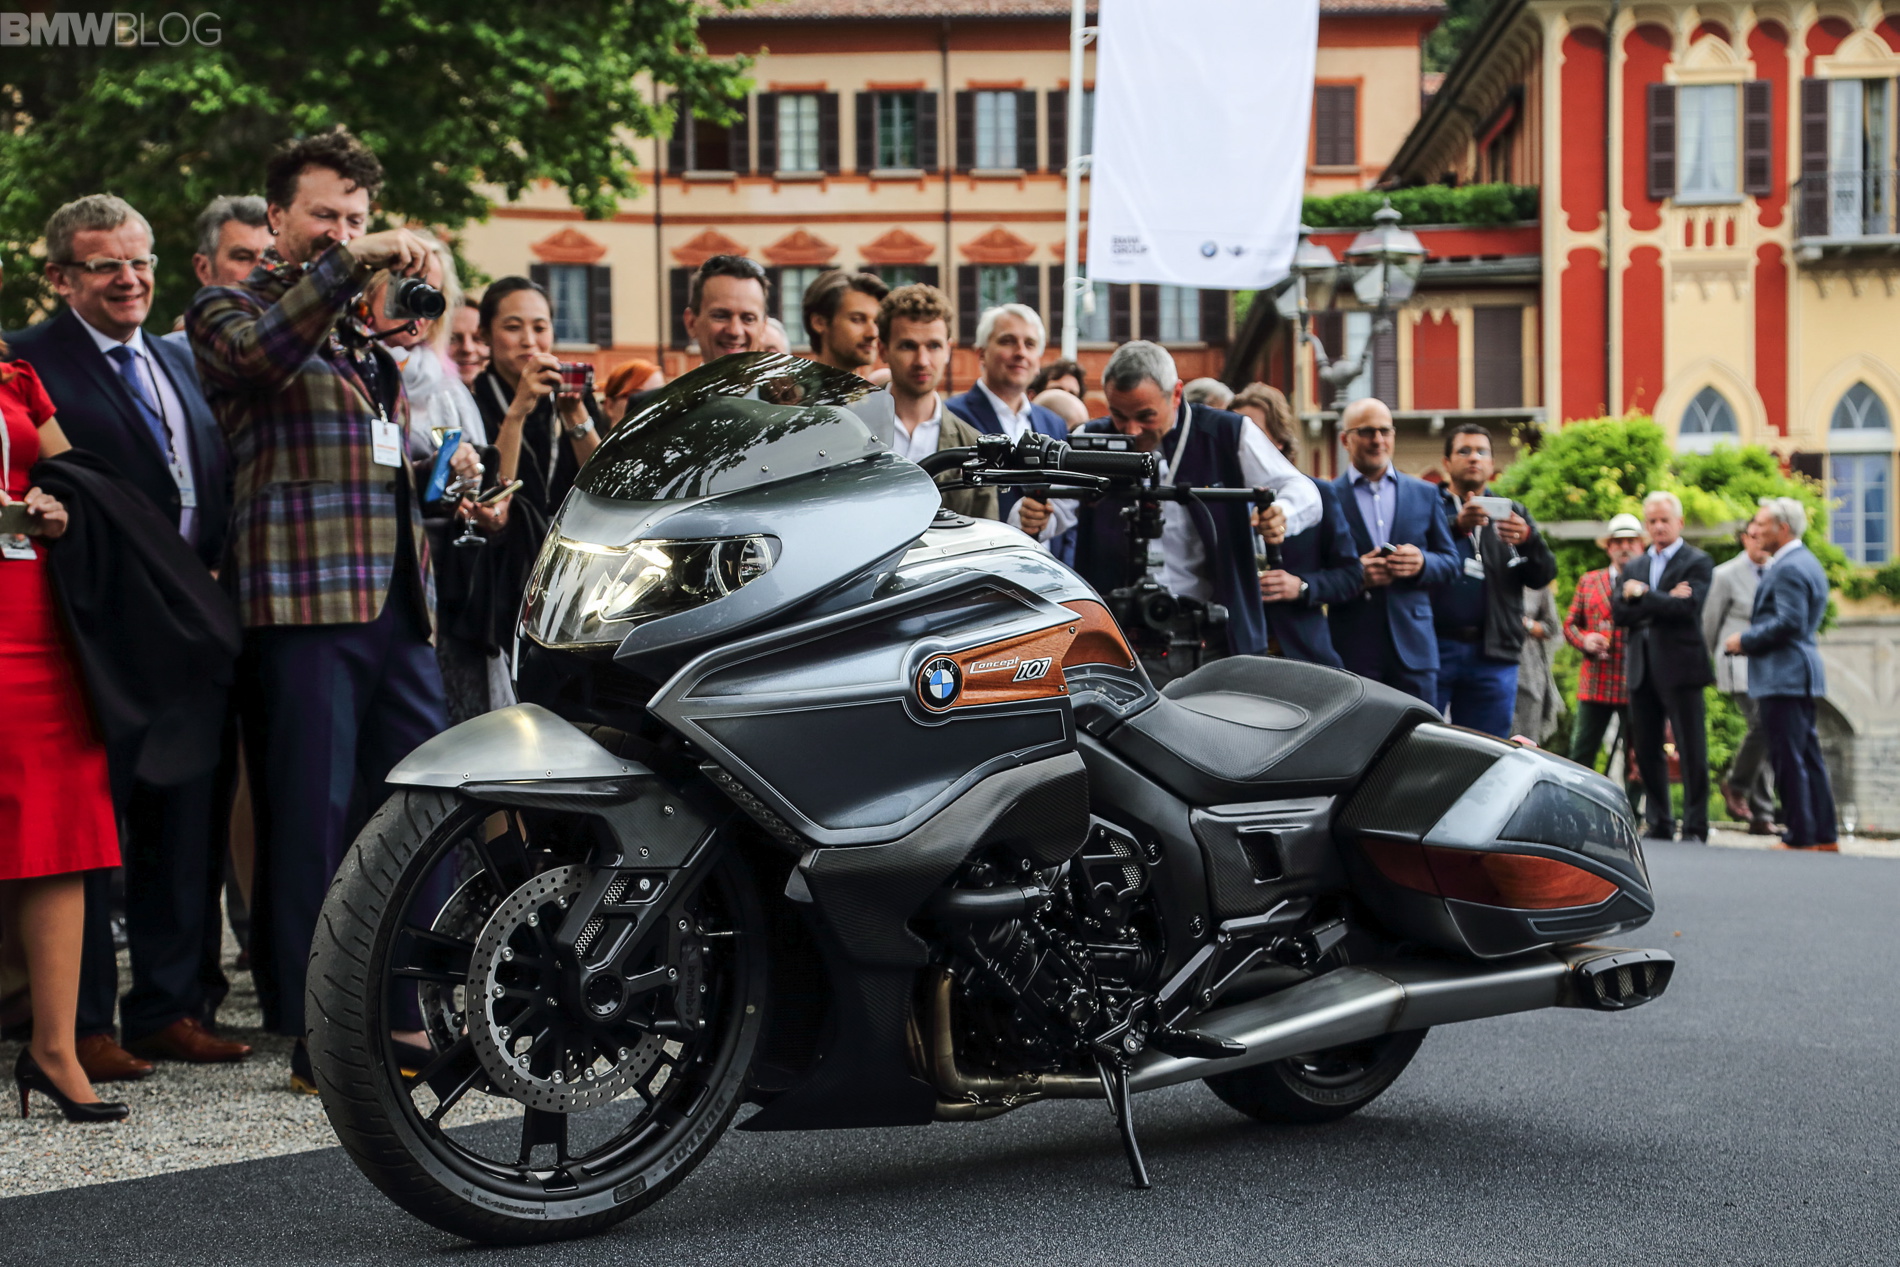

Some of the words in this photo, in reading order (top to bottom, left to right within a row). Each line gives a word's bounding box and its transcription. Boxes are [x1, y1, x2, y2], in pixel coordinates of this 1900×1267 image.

[969, 656, 1020, 674] Concept
[1017, 659, 1048, 681] 101
[685, 965, 697, 1015] brembo
[664, 1096, 727, 1172] DUNLOP
